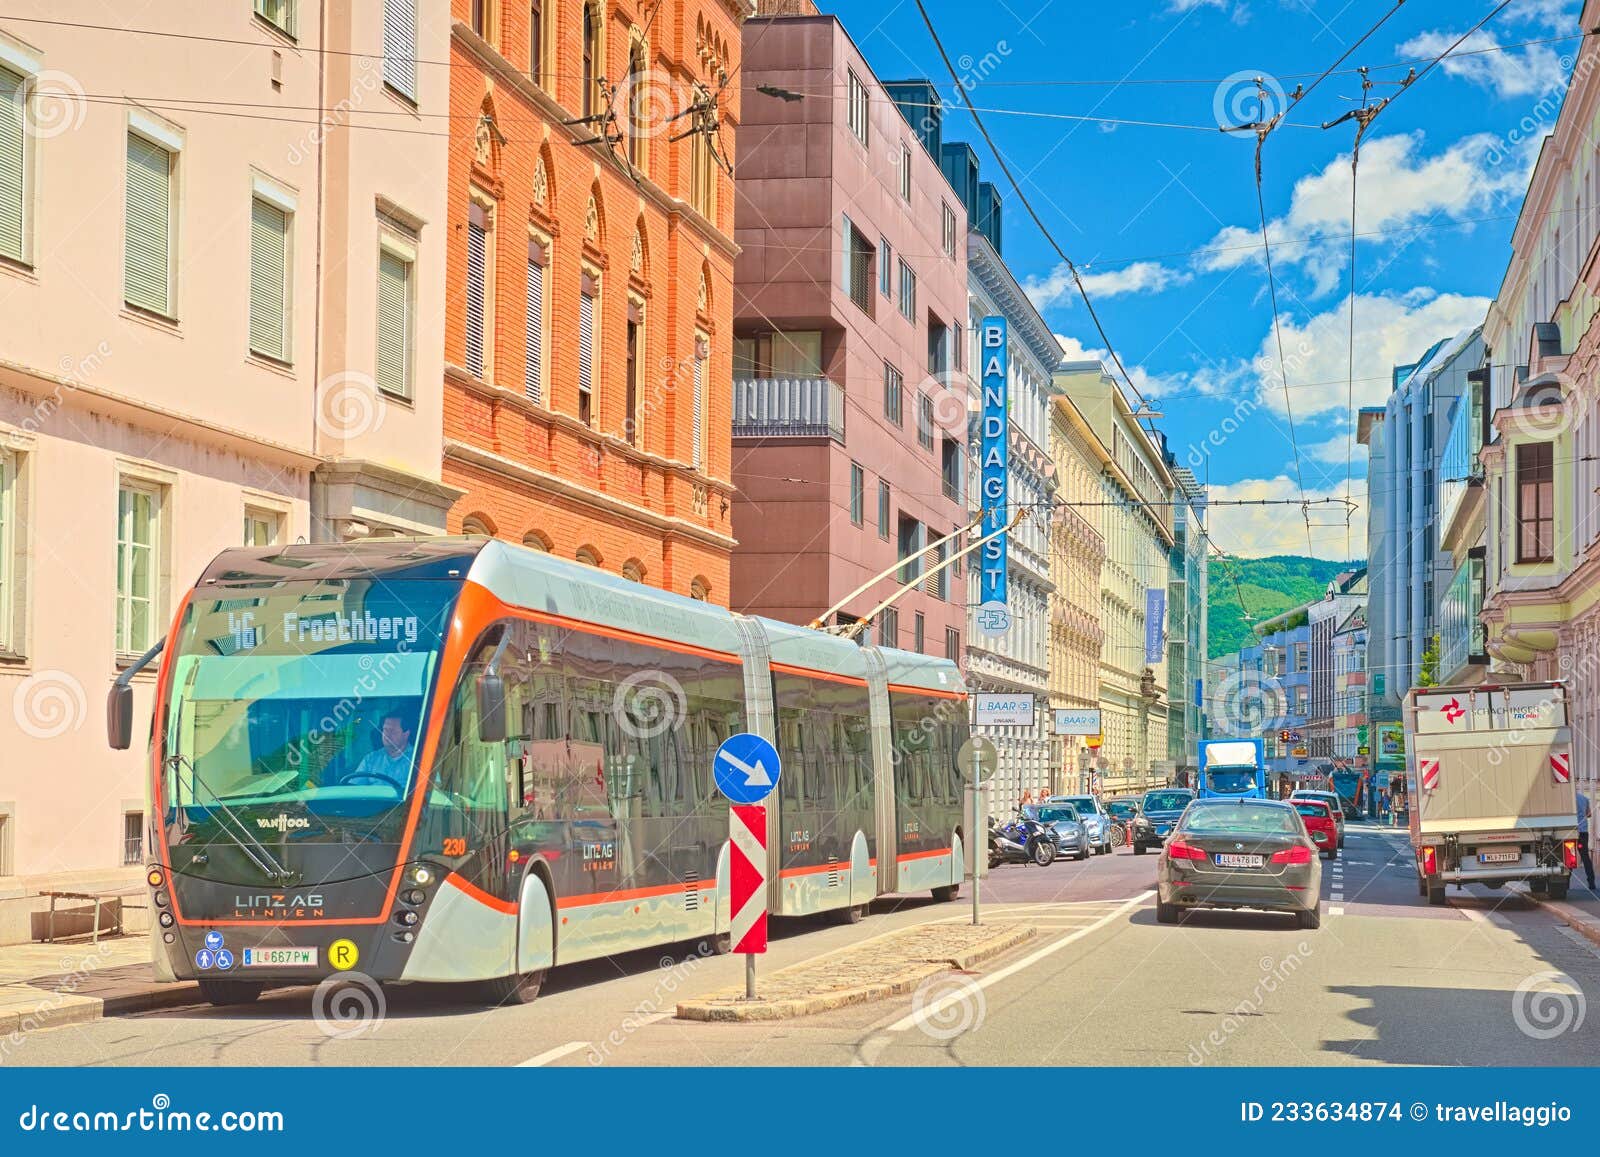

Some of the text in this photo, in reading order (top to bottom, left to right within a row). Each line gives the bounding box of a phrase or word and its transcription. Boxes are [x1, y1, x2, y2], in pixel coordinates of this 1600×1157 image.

[984, 326, 1004, 589] BANDAGIST
[228, 611, 417, 649] 46 Froschberg
[987, 701, 1016, 711] BAAR
[443, 838, 466, 856] 230
[583, 843, 613, 859] LINZ AG
[235, 893, 323, 908] LINZ AG
[235, 909, 324, 917] LINIEN
[337, 946, 350, 963] R
